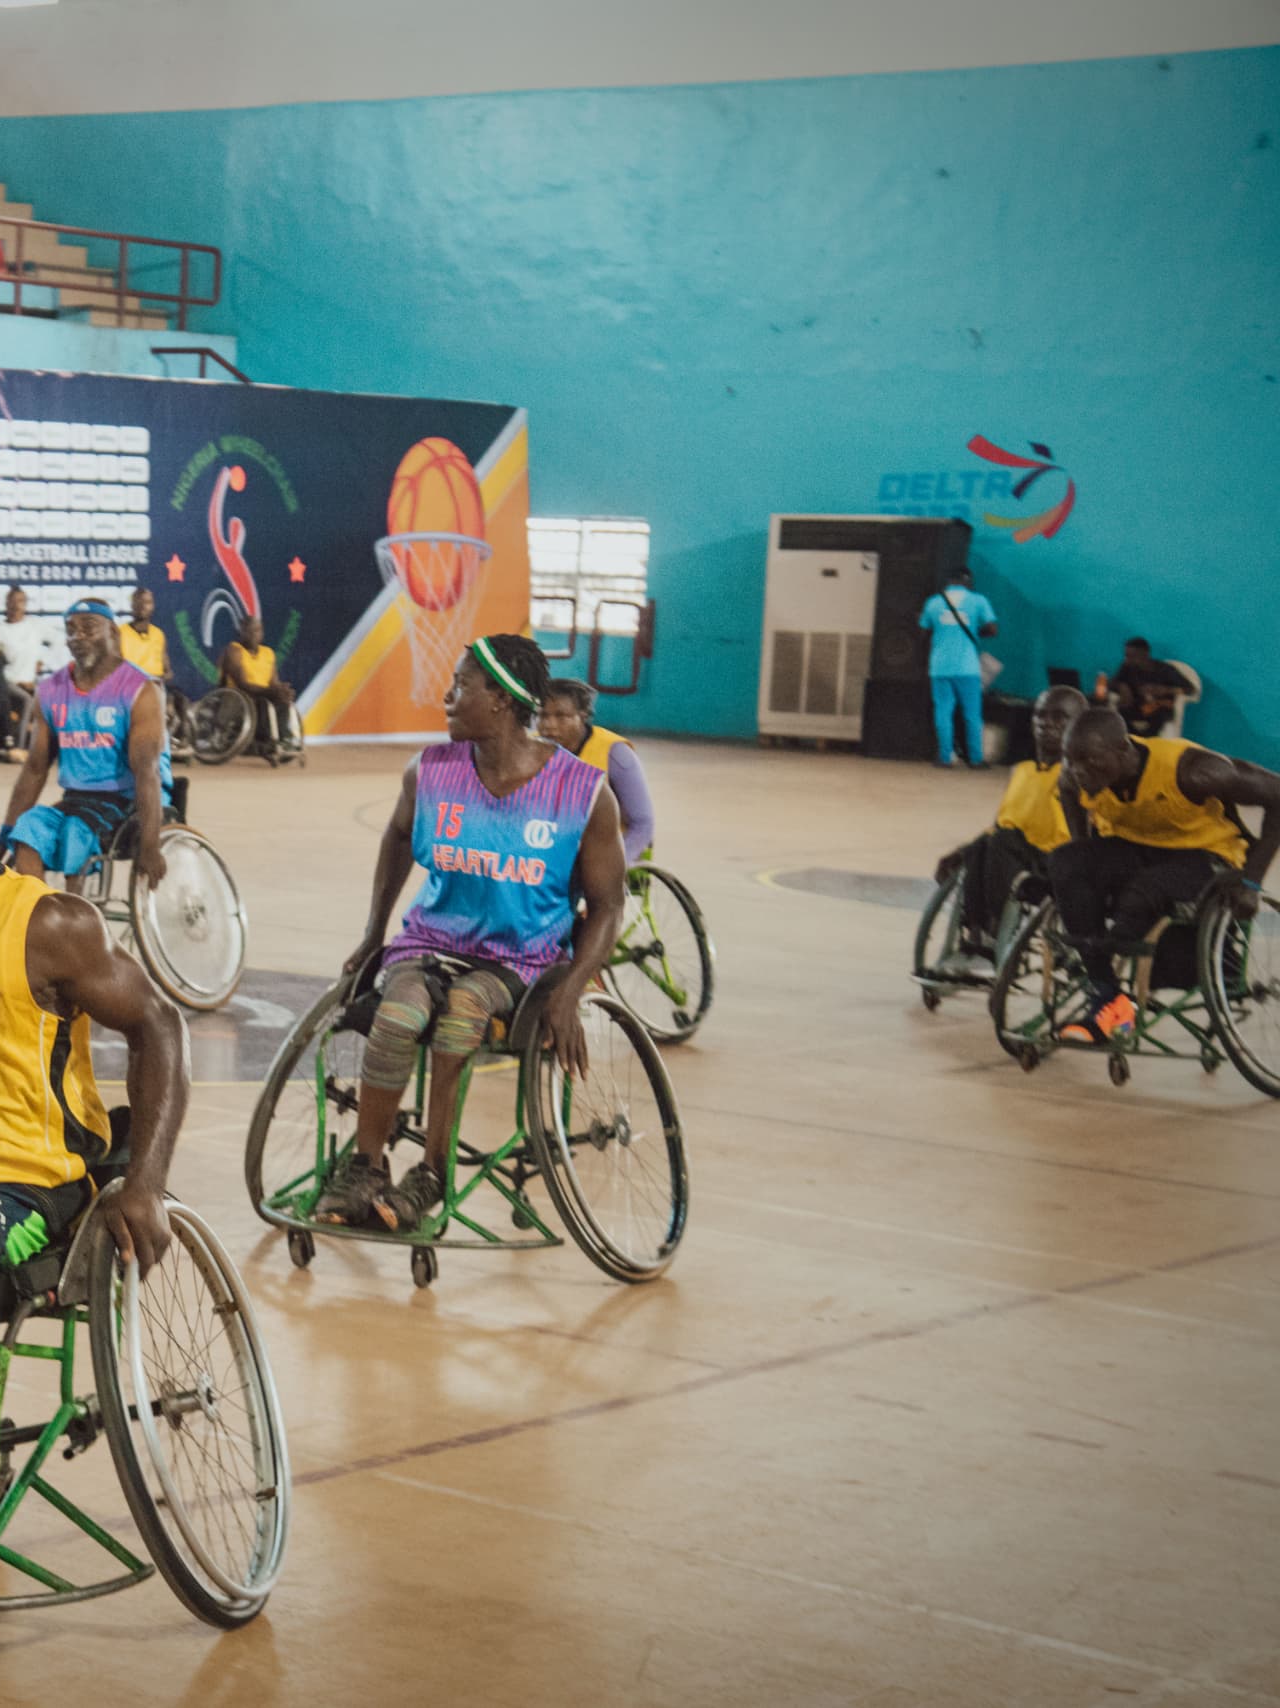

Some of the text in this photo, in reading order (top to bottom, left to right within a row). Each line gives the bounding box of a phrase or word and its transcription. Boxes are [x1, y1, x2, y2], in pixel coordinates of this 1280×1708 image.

[88, 544, 149, 564] LEAGUE
[41, 565, 81, 581] 2024
[84, 566, 138, 581] ASABA
[435, 802, 464, 839] 15
[433, 844, 546, 886] HEARTLAND
